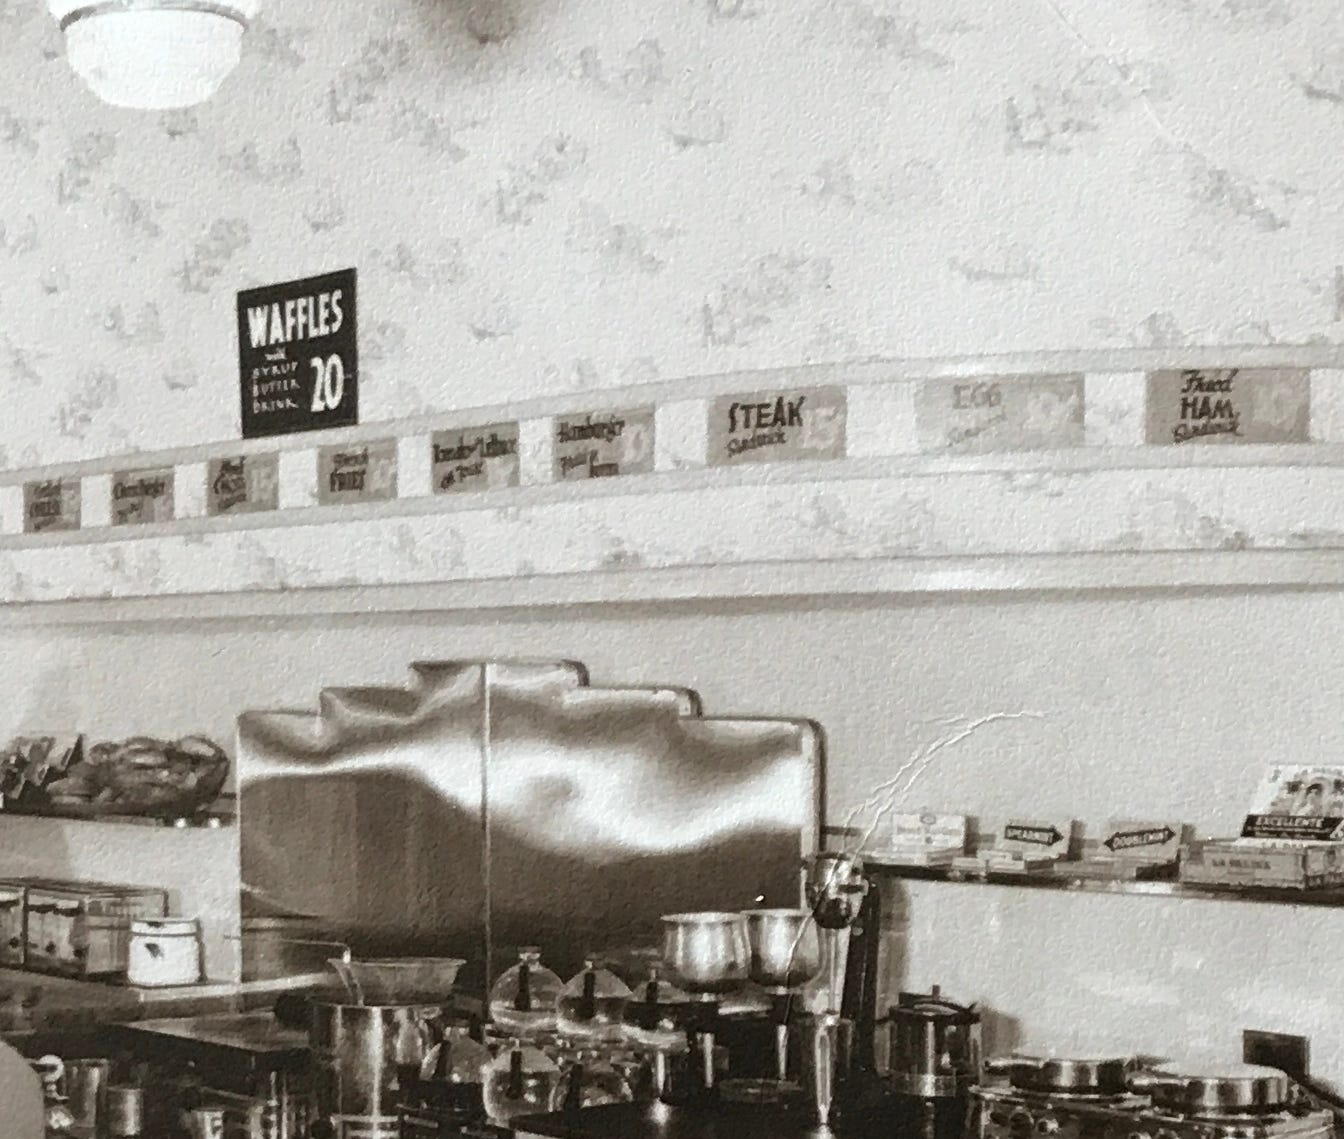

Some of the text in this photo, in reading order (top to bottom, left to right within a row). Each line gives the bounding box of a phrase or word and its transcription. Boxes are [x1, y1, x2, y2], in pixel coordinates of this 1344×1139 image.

[248, 289, 343, 348] WAFFLES
[310, 353, 344, 412] 20
[728, 396, 805, 433] STEAK
[1181, 397, 1234, 419] HAM
